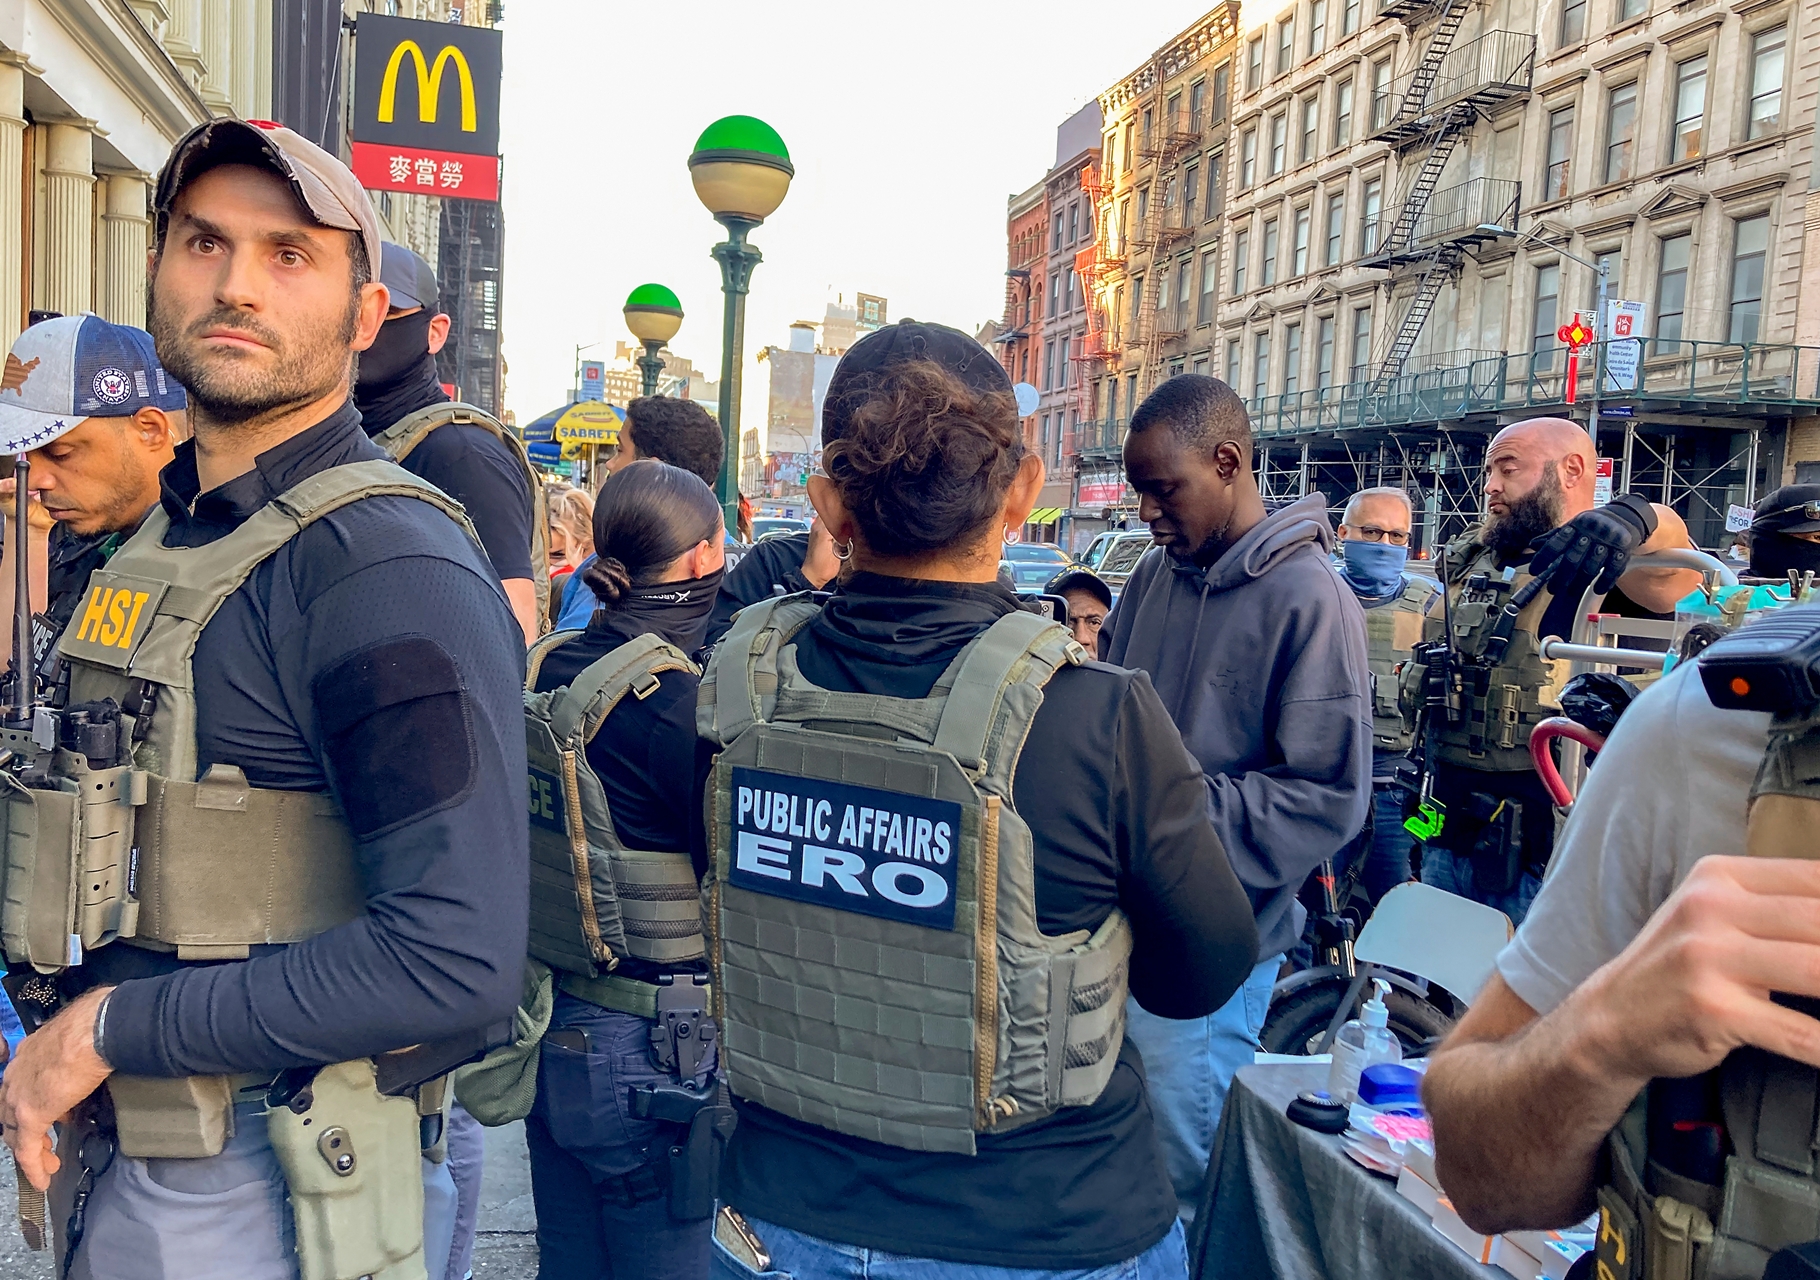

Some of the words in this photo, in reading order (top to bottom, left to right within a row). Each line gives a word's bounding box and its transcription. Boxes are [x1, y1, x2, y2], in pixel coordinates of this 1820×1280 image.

[389, 155, 464, 189] 麥當勞
[94, 369, 114, 392] UNITED
[113, 370, 130, 394] STATES
[103, 394, 124, 403] NAVY
[76, 586, 149, 649] HSI
[737, 786, 832, 841] PUBLIC
[838, 804, 951, 864] AFFAIRS
[736, 831, 949, 907] ERO
